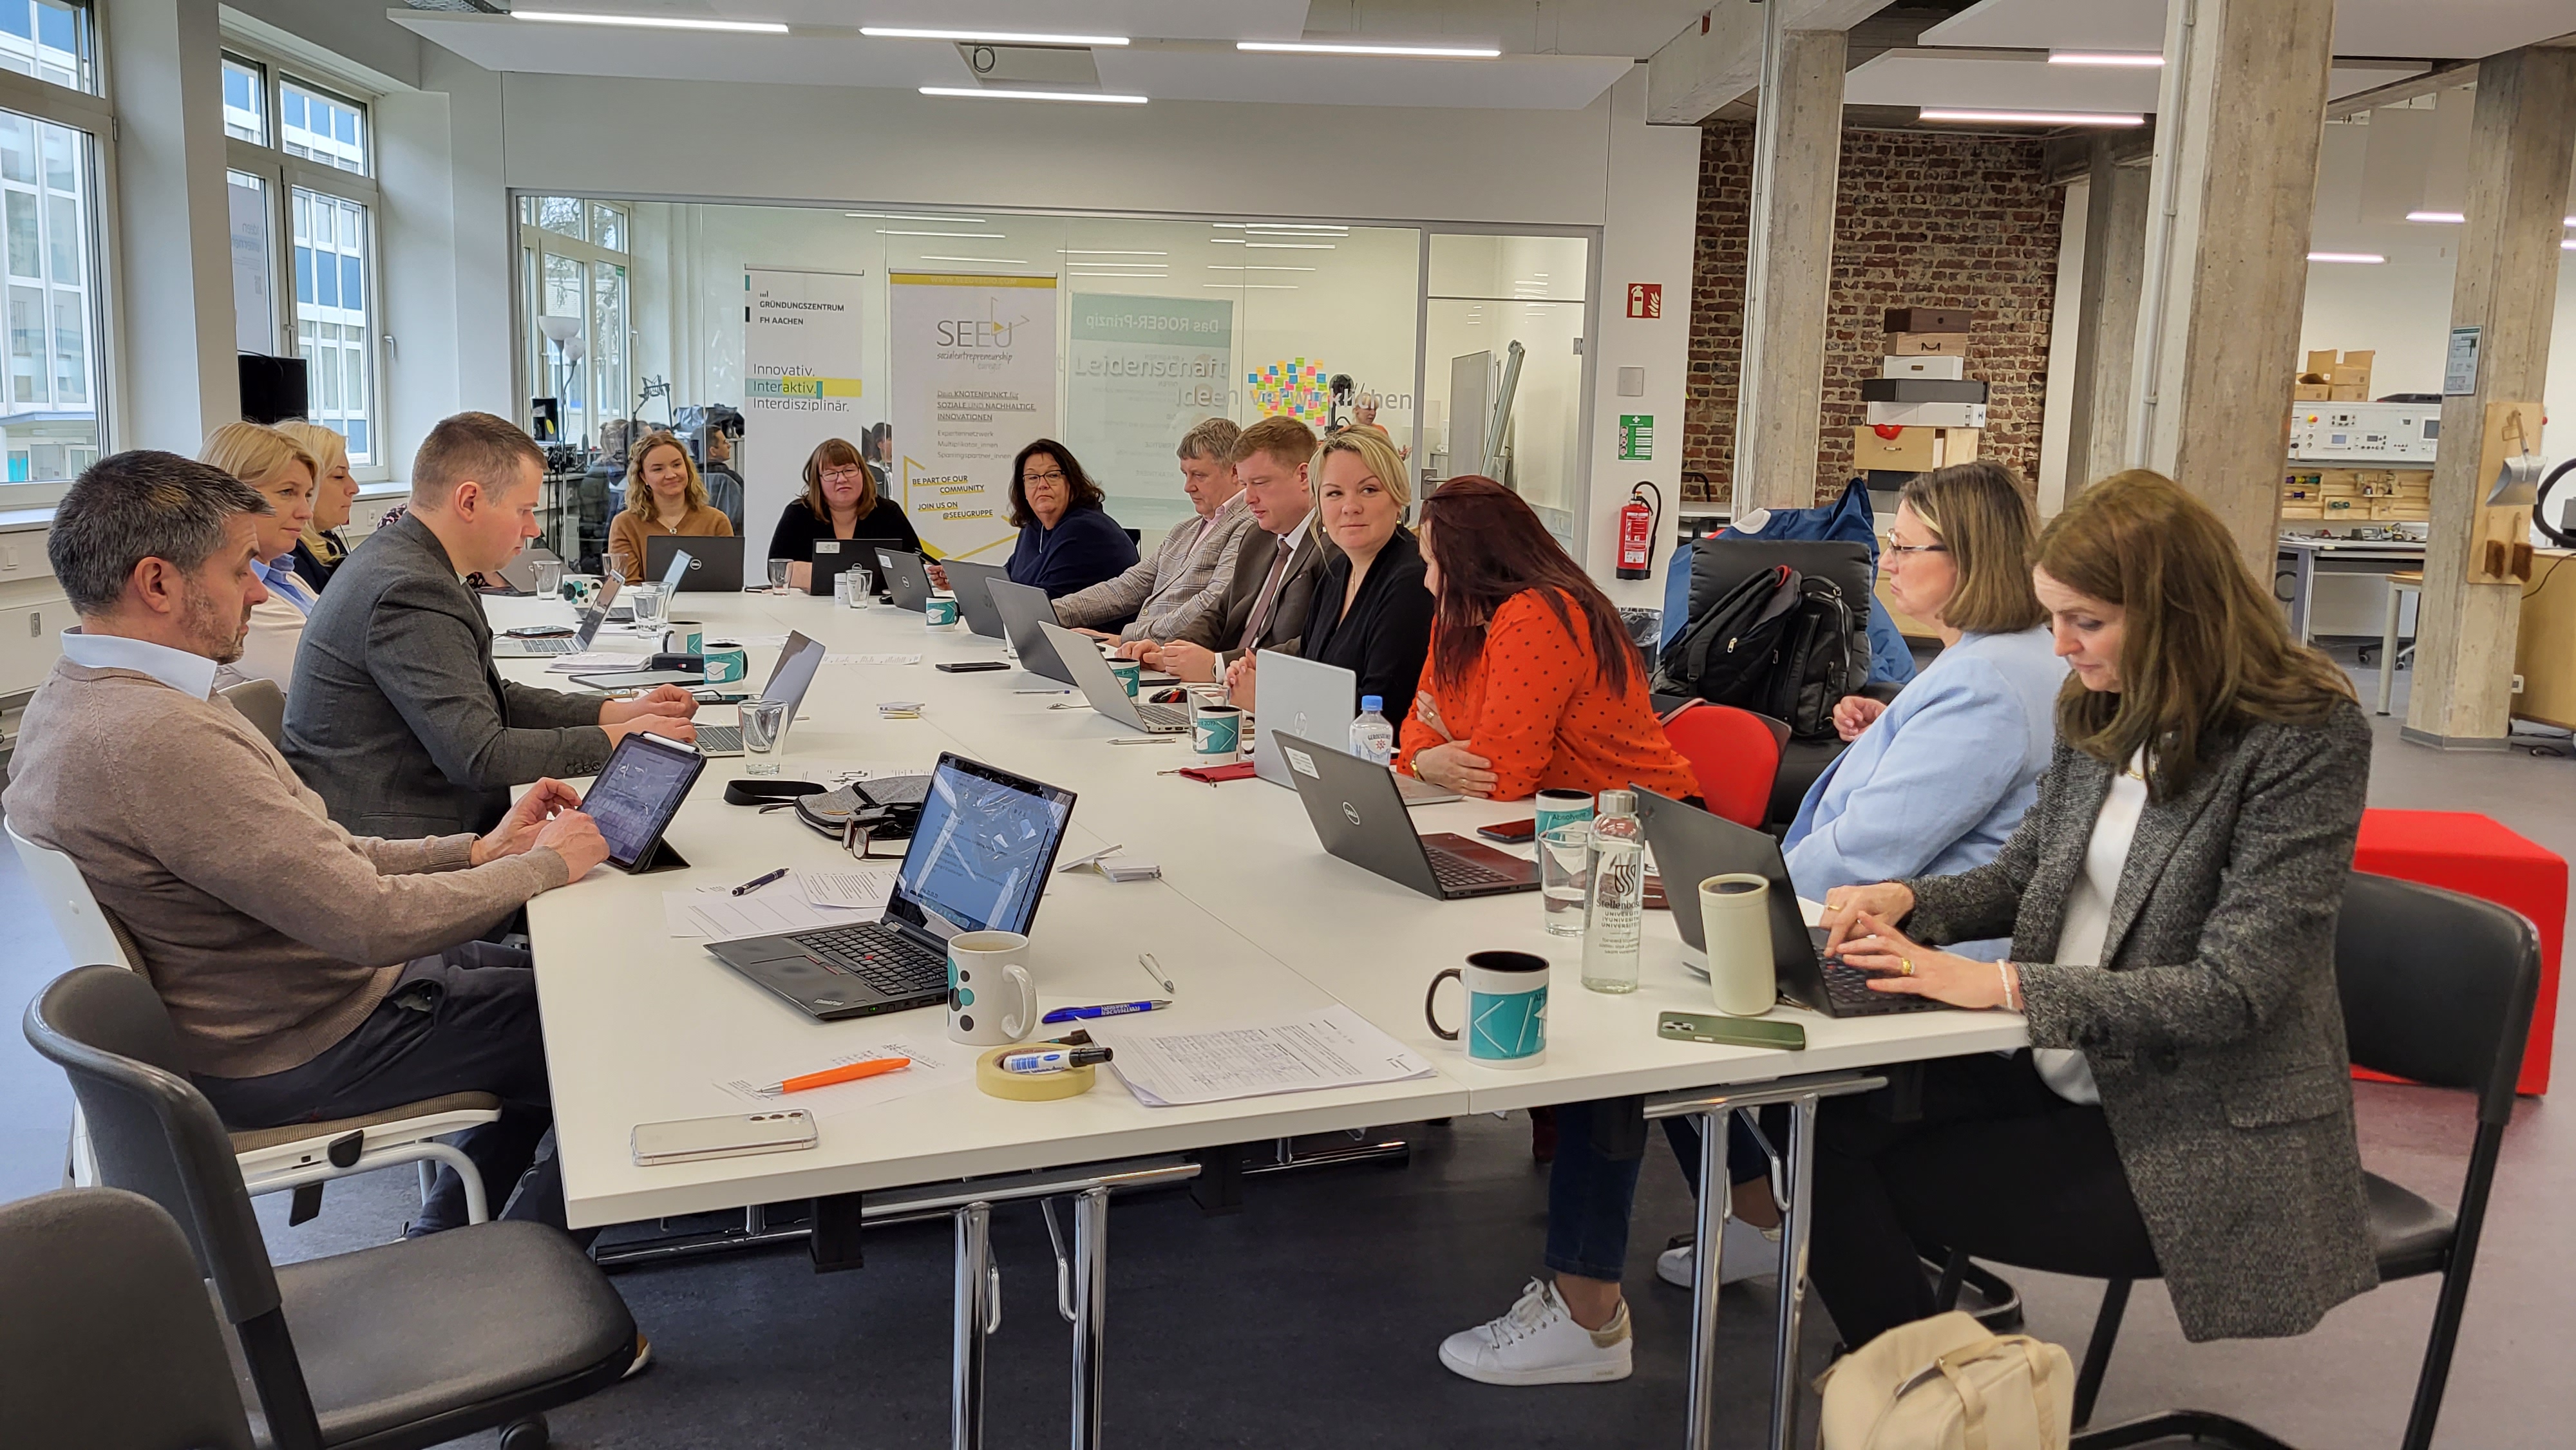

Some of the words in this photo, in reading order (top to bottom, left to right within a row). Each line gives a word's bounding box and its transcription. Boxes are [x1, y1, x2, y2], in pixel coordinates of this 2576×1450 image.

[760, 300, 844, 312] GRÜNDUNGSZENTRUM
[772, 317, 804, 325] AACHEN
[936, 320, 1013, 348] SEEU
[753, 364, 815, 377] Innovativ.
[1075, 354, 1227, 379] Leidenschaft
[753, 381, 817, 394] Interaktiv.
[753, 398, 849, 412] Interdisziplinär.
[1176, 387, 1239, 407] Ideen
[1249, 388, 1412, 410] verwirklichen
[940, 484, 985, 494] COMMUNITY
[943, 509, 993, 520] @SEEUGRUPPE
